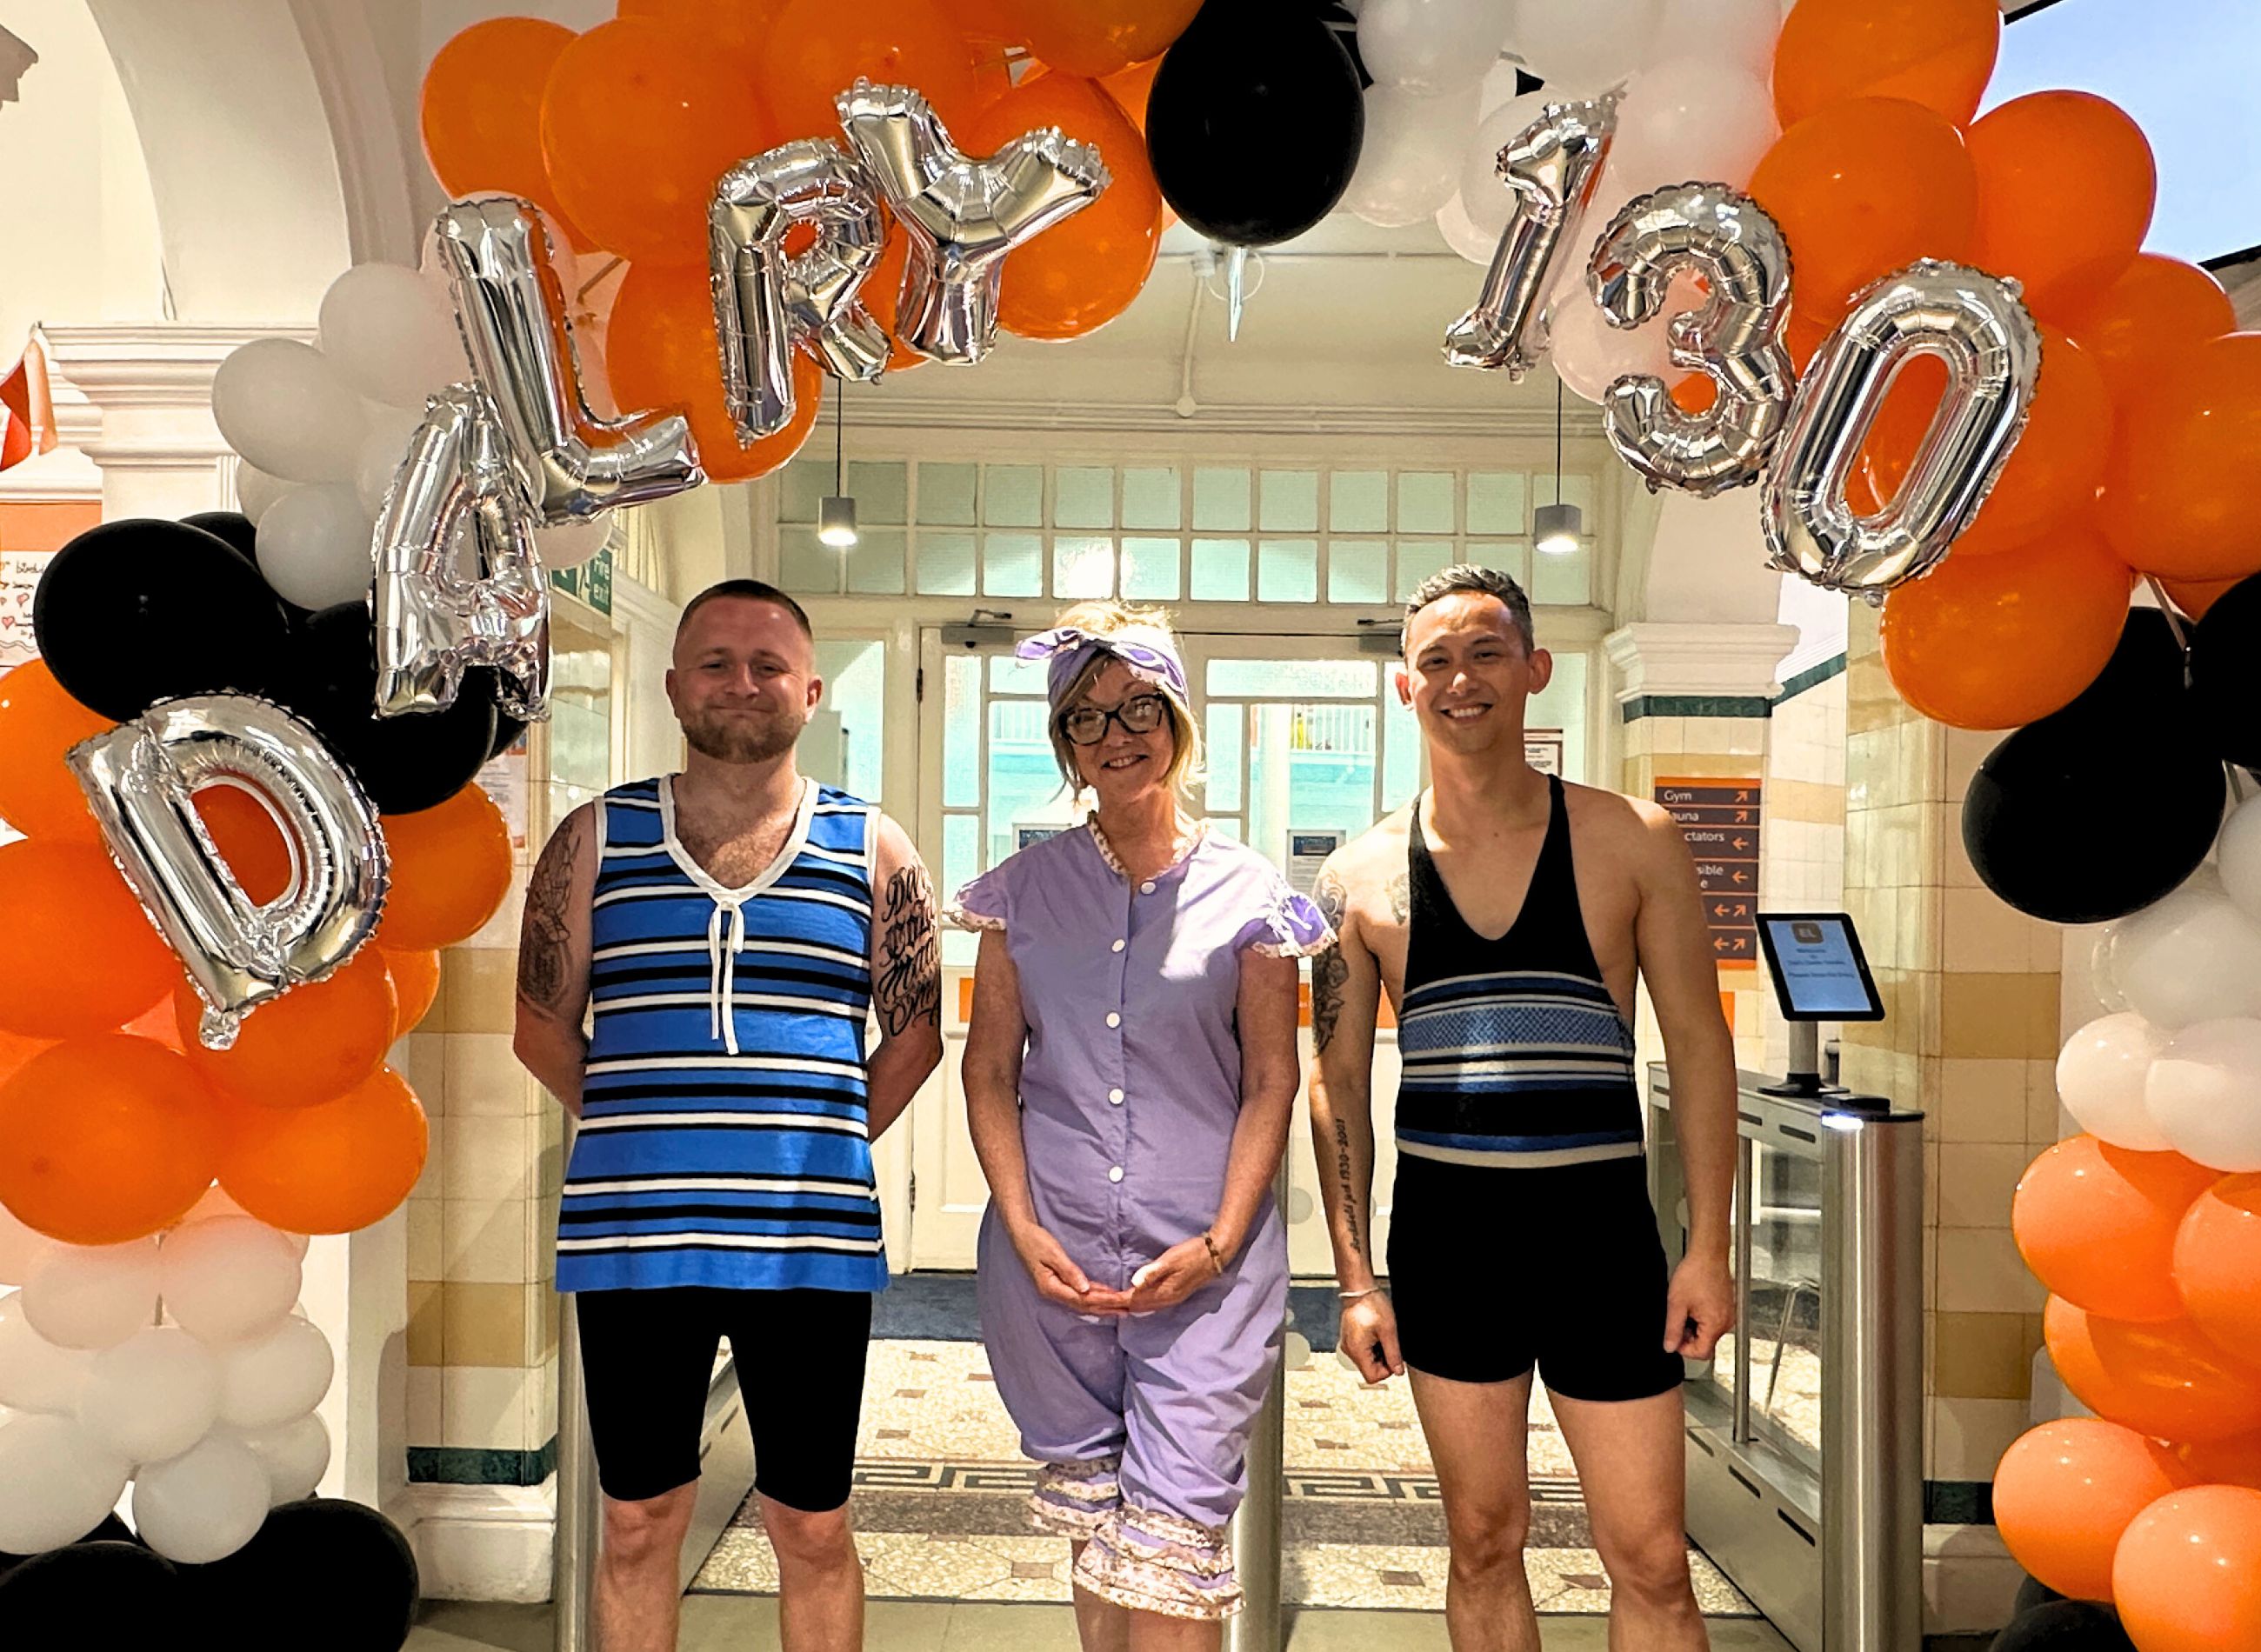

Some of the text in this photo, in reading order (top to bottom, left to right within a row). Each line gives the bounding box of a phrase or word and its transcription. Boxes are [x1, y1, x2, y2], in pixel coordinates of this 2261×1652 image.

[68, 75, 2042, 1050] DALRY 130
[1664, 789, 1693, 804] Gym
[1672, 811, 1700, 822] auna
[1684, 831, 1725, 843] ctators
[1696, 864, 1724, 876] sible
